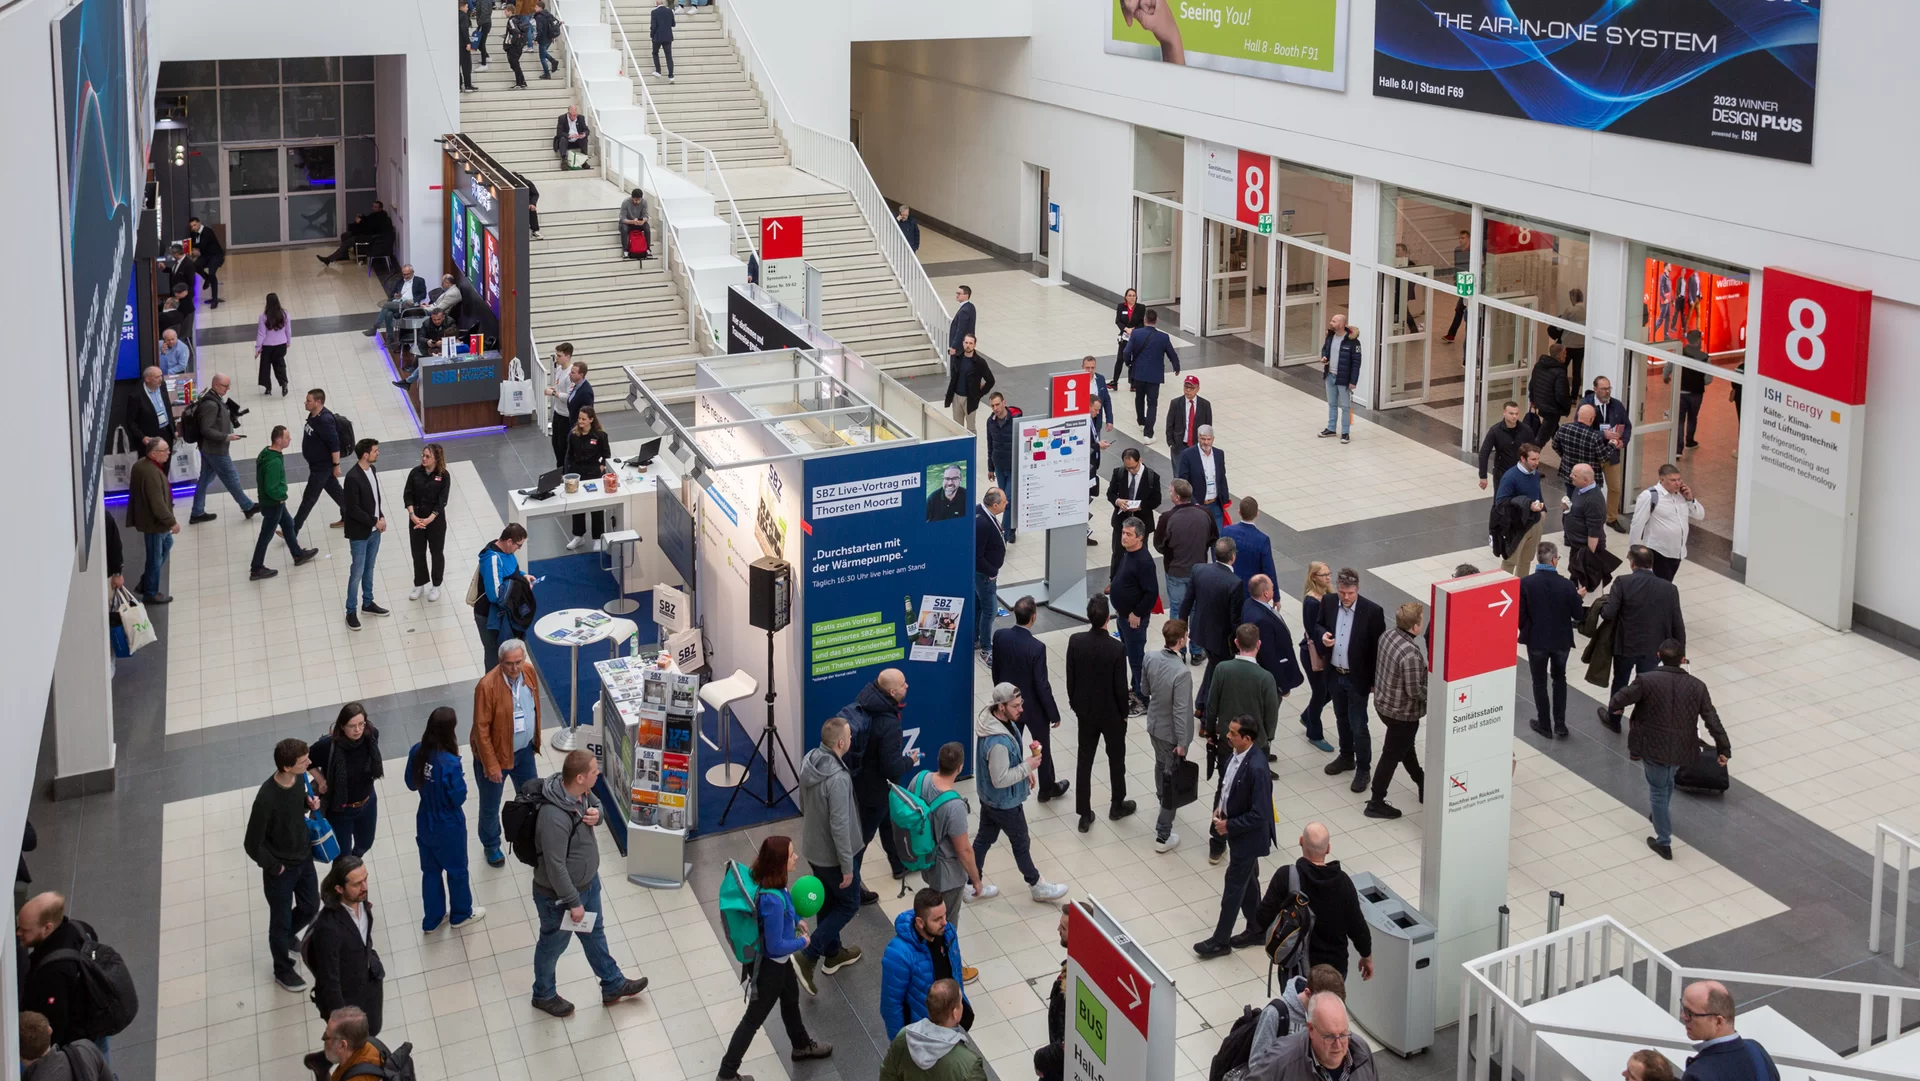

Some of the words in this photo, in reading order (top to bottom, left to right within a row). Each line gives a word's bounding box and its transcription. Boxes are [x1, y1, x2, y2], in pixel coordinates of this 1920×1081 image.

[1180, 1, 1222, 28] Seeing
[1225, 6, 1252, 26] You!
[1434, 12, 1472, 31] THE
[1478, 16, 1597, 42] AIR-IN-ONE
[1606, 26, 1718, 54] SYSTEM
[1244, 38, 1261, 53] Hall
[1262, 41, 1268, 53] 8
[1274, 40, 1300, 59] Booth
[1379, 76, 1400, 90] Halle
[1400, 78, 1414, 92] 8.0
[1420, 81, 1445, 96] Stand
[1447, 84, 1464, 98] F69
[1713, 95, 1737, 108] 2023
[1738, 97, 1778, 112] WINNER
[1712, 108, 1759, 128] DESIGN
[1711, 130, 1731, 140] powered
[1741, 129, 1758, 142] ISH
[1244, 166, 1264, 212] 8
[1785, 298, 1827, 371] 8
[461, 364, 495, 373] TURKISH
[461, 372, 495, 381] HVAC-R
[1764, 386, 1782, 403] ISH
[1786, 394, 1823, 420] Energy
[1763, 405, 1786, 422] Kälte-,
[1788, 415, 1812, 429] Klima-
[1762, 418, 1776, 429] und
[1778, 421, 1838, 452] Lüftungstechnik
[1762, 431, 1807, 456] Refrigeration,
[1761, 443, 1814, 470] air-conditioning
[1816, 463, 1830, 476] and
[769, 463, 782, 497] SBZ
[1760, 454, 1796, 474] ventilation
[1797, 467, 1837, 490] technology
[816, 488, 836, 499] SBZ
[838, 479, 899, 496] Live-Vortrag
[901, 476, 917, 487] mit
[816, 500, 861, 516] Thorsten
[863, 496, 899, 508] Moortz
[884, 538, 900, 548] mit
[812, 563, 830, 574] der
[812, 577, 836, 588] Täglich
[837, 574, 855, 584] 16:30
[857, 572, 869, 581] Uhr
[870, 570, 881, 579] live
[882, 568, 895, 577] hier
[908, 563, 926, 572] Stand
[659, 599, 676, 615] SBZ
[934, 598, 952, 608] SBZ
[815, 623, 835, 632] Gratis
[836, 621, 850, 629] zum
[852, 615, 878, 626] Vortrag:
[815, 637, 826, 646] ein
[826, 632, 860, 644] limitiertes
[815, 650, 829, 660] und
[830, 648, 841, 656] das
[842, 639, 893, 654] SBZ-Sonderheft
[678, 643, 696, 661] SBZ
[815, 665, 830, 673] zum
[831, 660, 853, 670] Thema
[855, 652, 902, 667] Wärmepumpe.
[1452, 704, 1503, 724] Sanitätsstation
[1452, 724, 1467, 735] First
[1468, 721, 1478, 731] aid
[1479, 716, 1502, 728] station
[587, 743, 602, 756] SB
[1448, 796, 1470, 807] Rauchfrei
[1080, 998, 1103, 1041] BUS
